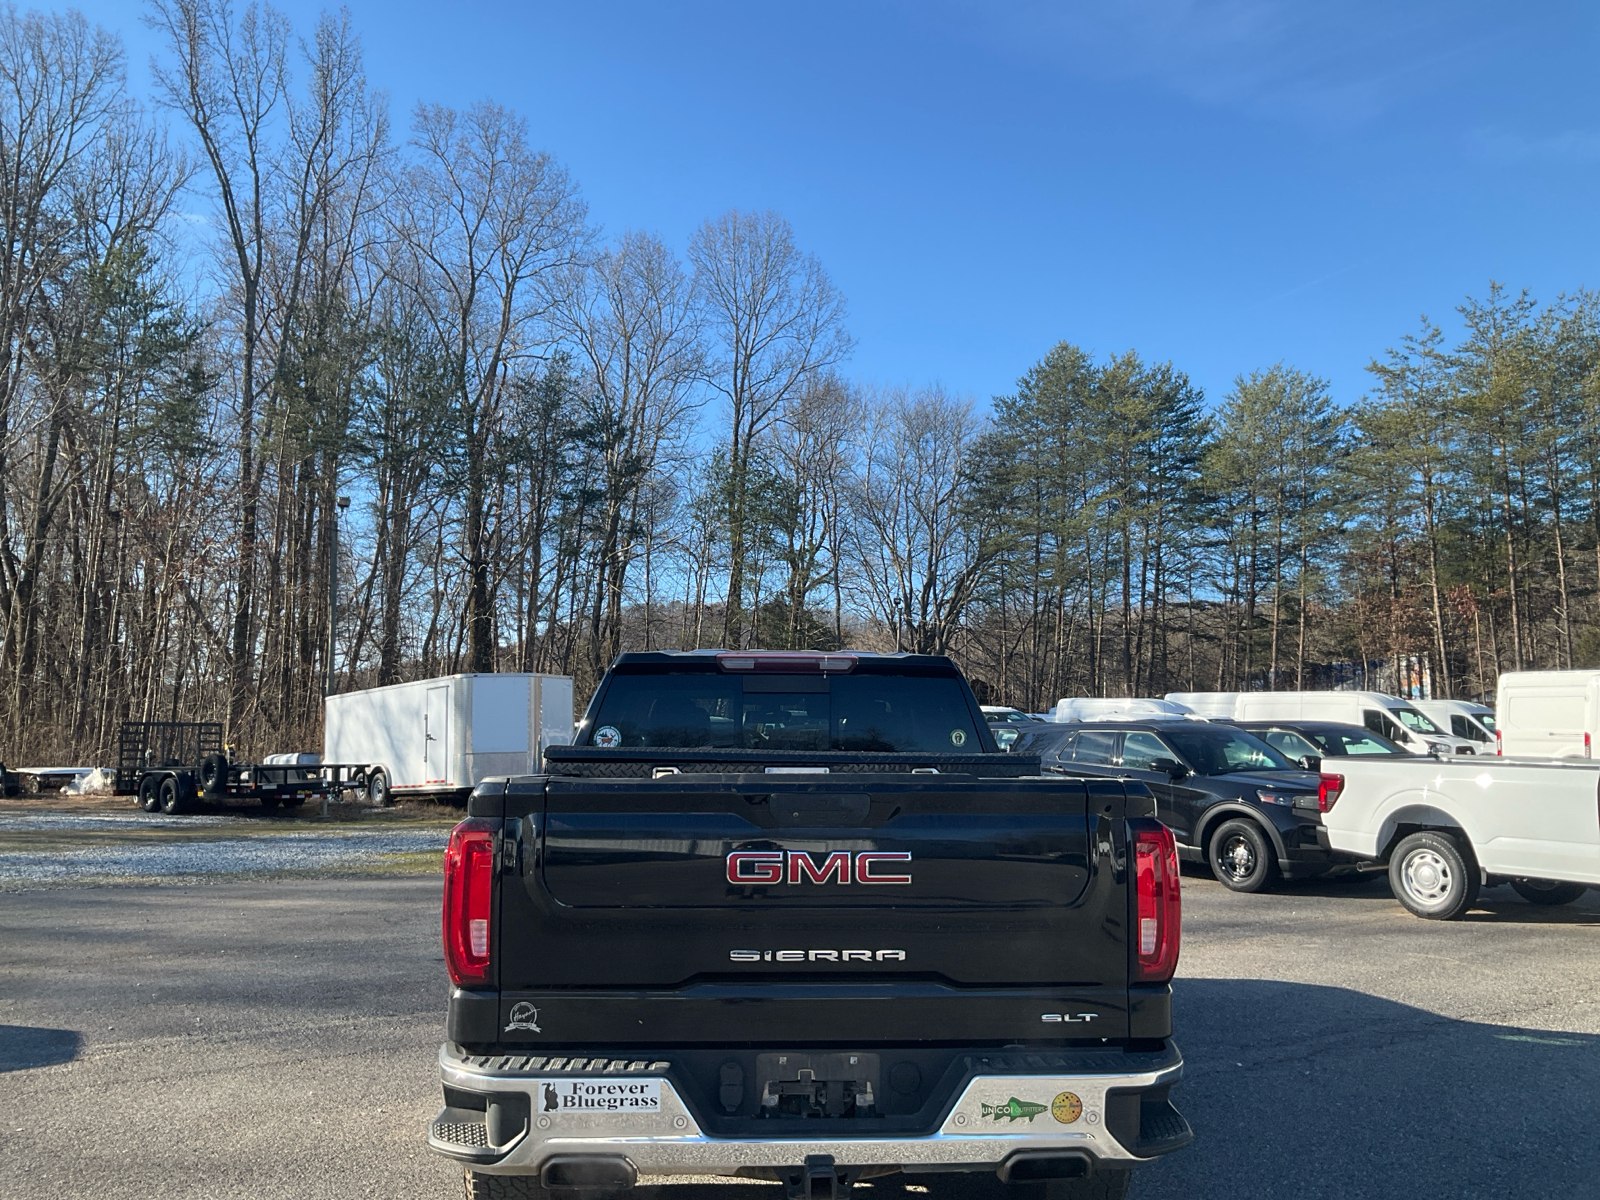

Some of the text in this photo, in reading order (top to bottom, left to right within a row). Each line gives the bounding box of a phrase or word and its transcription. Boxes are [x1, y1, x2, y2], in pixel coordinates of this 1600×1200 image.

[726, 851, 912, 884] GMC
[729, 949, 906, 962] SIERRA
[1041, 1013, 1098, 1022] SLT
[572, 1082, 649, 1095] Forever
[562, 1095, 658, 1110] Bluegrass
[982, 1106, 1013, 1114] UNICOI
